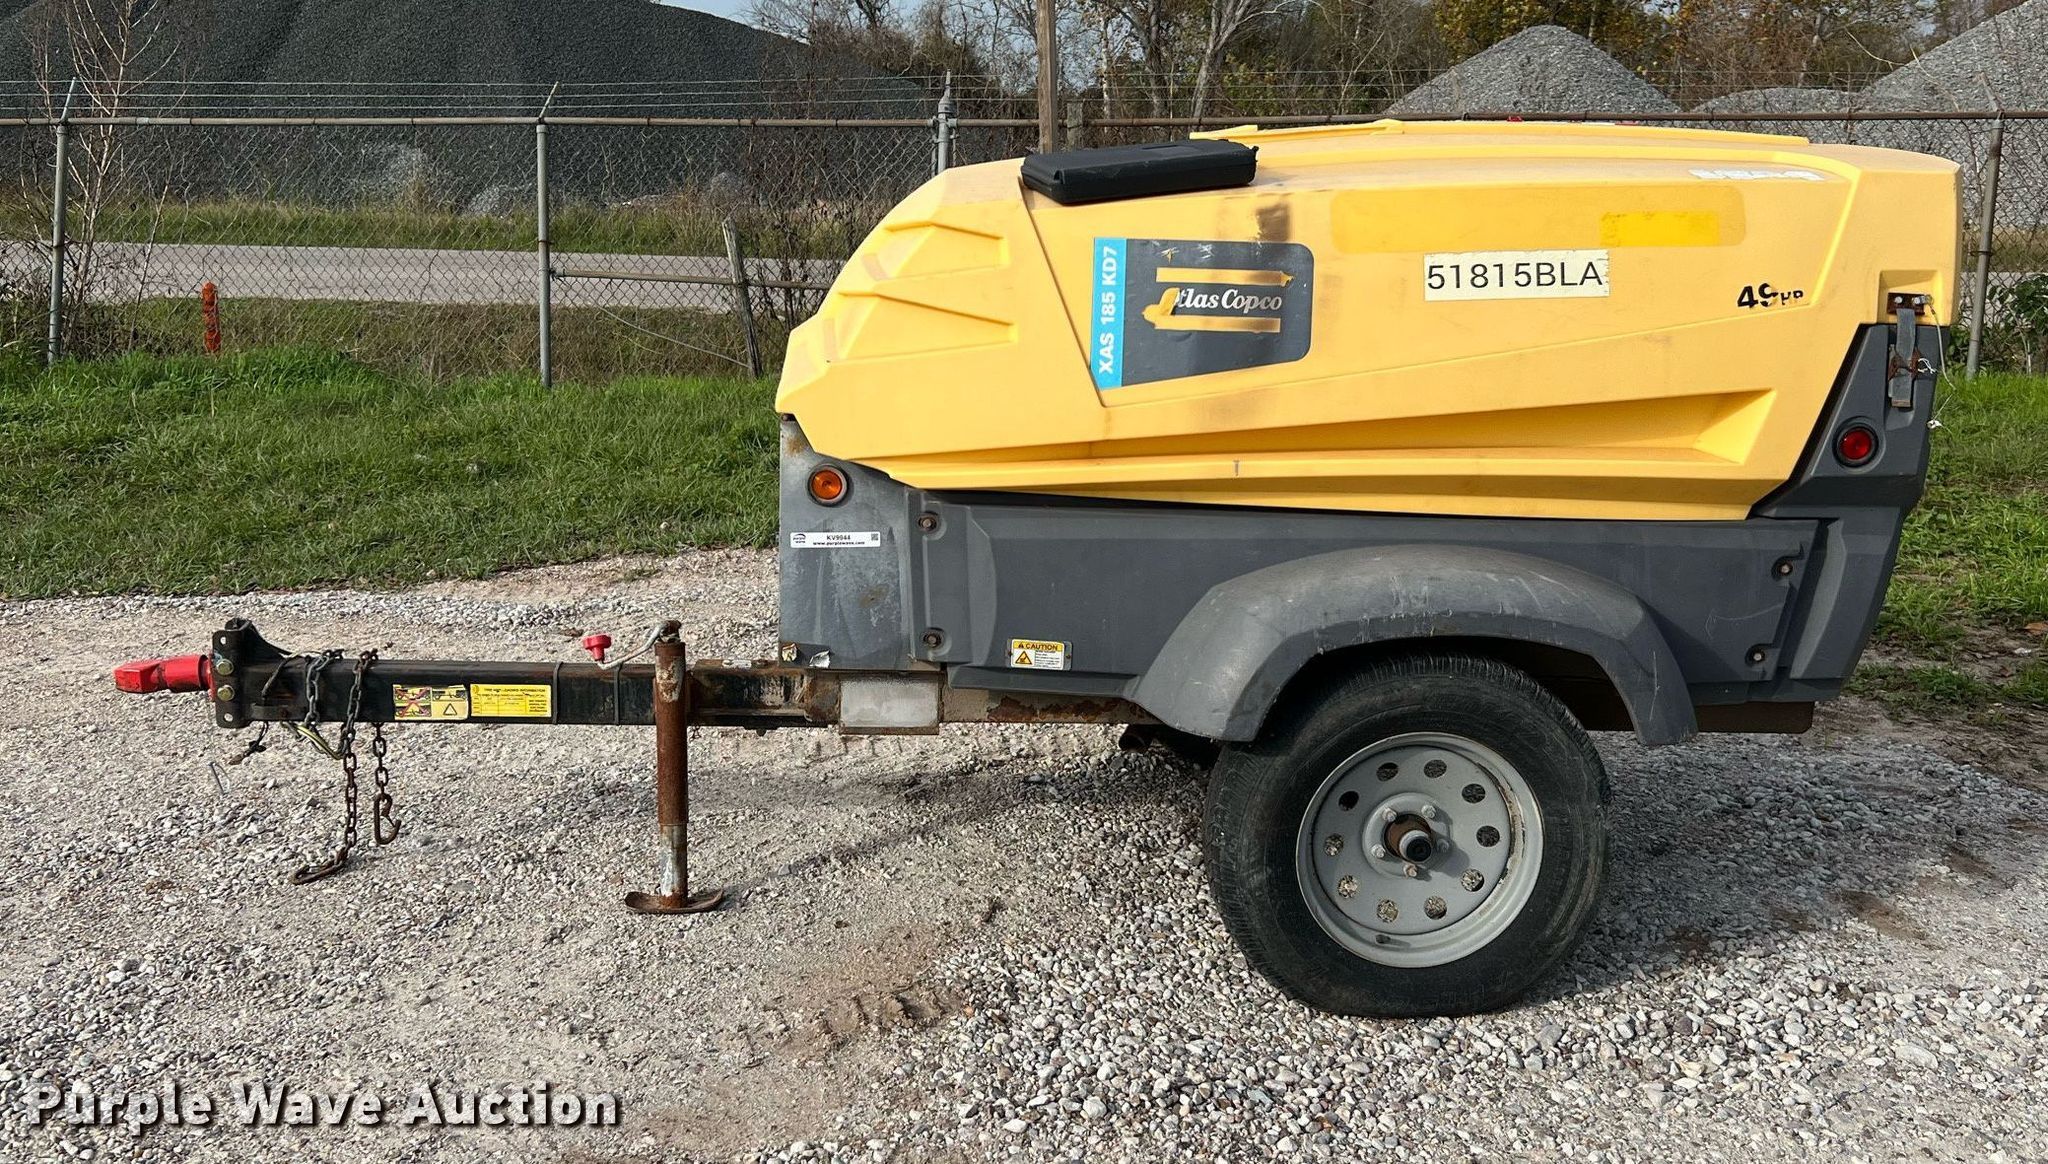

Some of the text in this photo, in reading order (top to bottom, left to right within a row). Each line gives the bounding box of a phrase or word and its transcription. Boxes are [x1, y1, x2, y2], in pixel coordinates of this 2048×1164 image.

[1427, 260, 1603, 290] 51815BLA
[1098, 246, 1118, 374] XAS 185 KD7
[1168, 287, 1283, 314] tlas Copco
[1025, 643, 1058, 651] CAUTION
